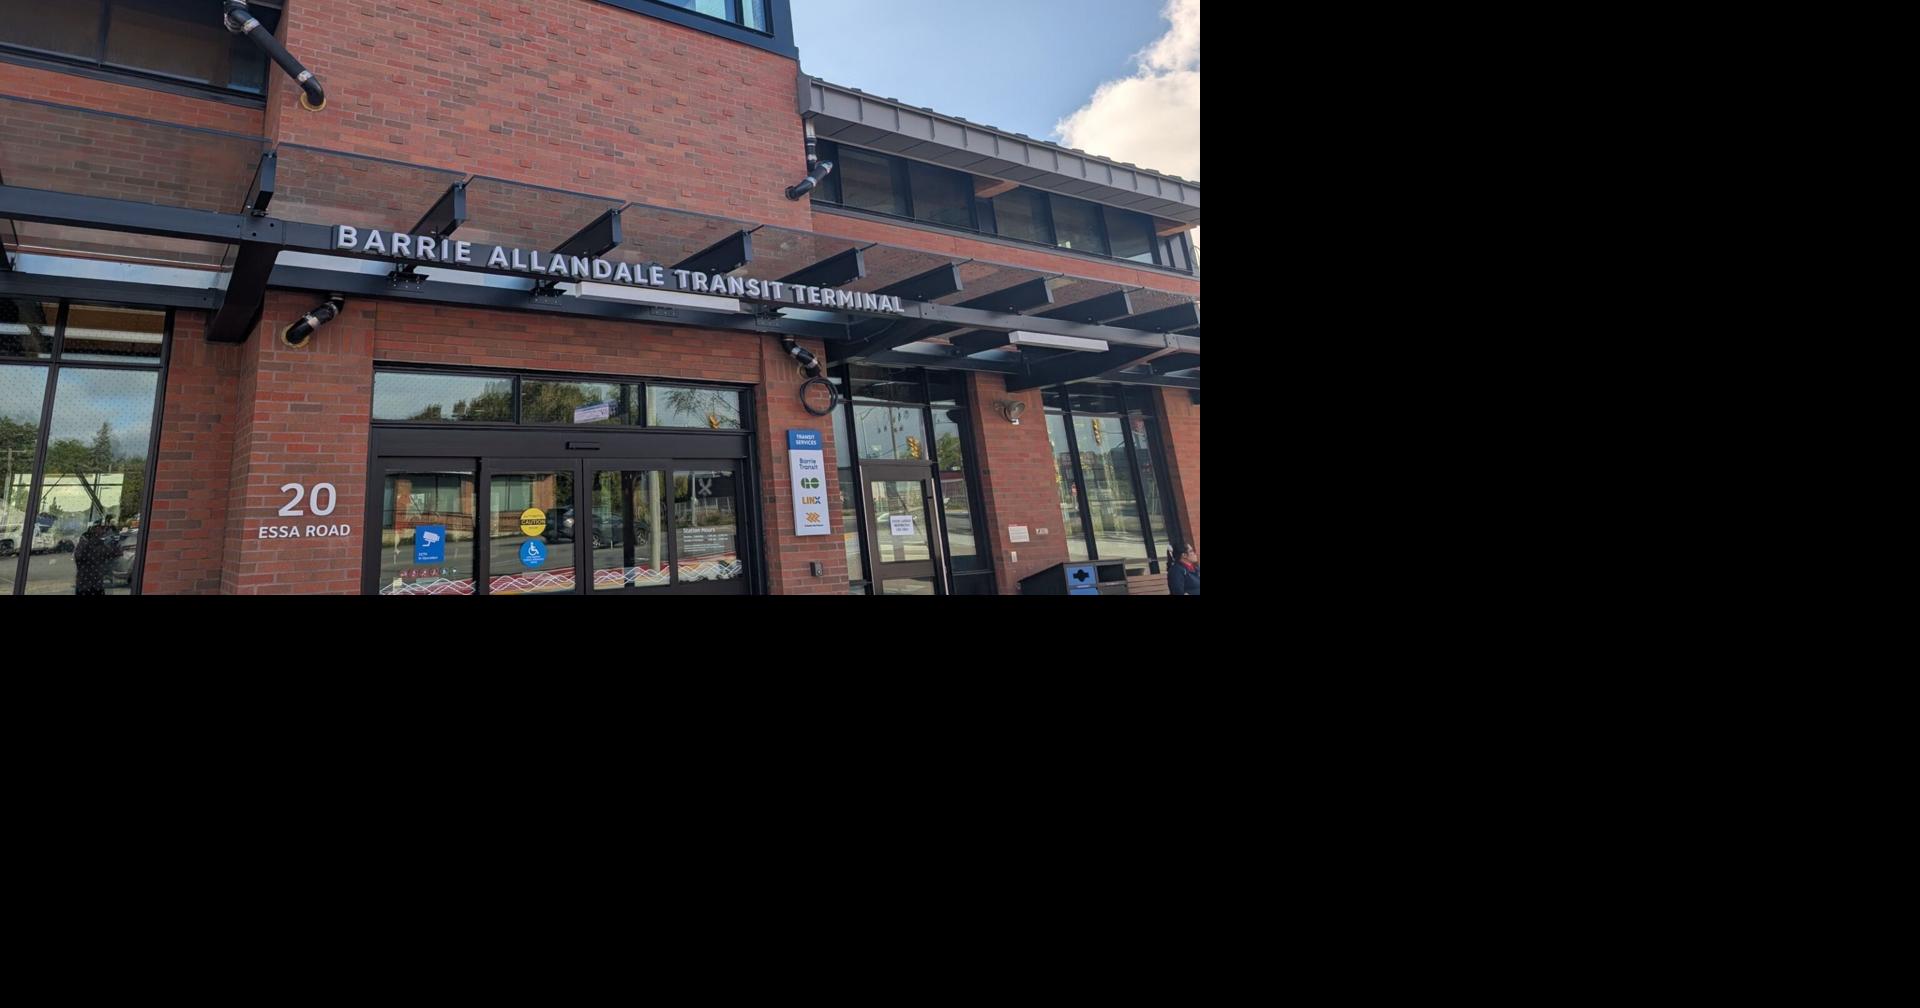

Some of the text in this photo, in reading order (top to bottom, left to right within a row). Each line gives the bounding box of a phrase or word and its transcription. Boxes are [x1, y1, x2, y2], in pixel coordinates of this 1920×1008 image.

[336, 223, 906, 314] BARRIE ALLANDALE TRANSIT TERMINAL
[278, 482, 338, 517] 20
[802, 496, 821, 505] LINX
[258, 524, 351, 539] ESSA ROAD
